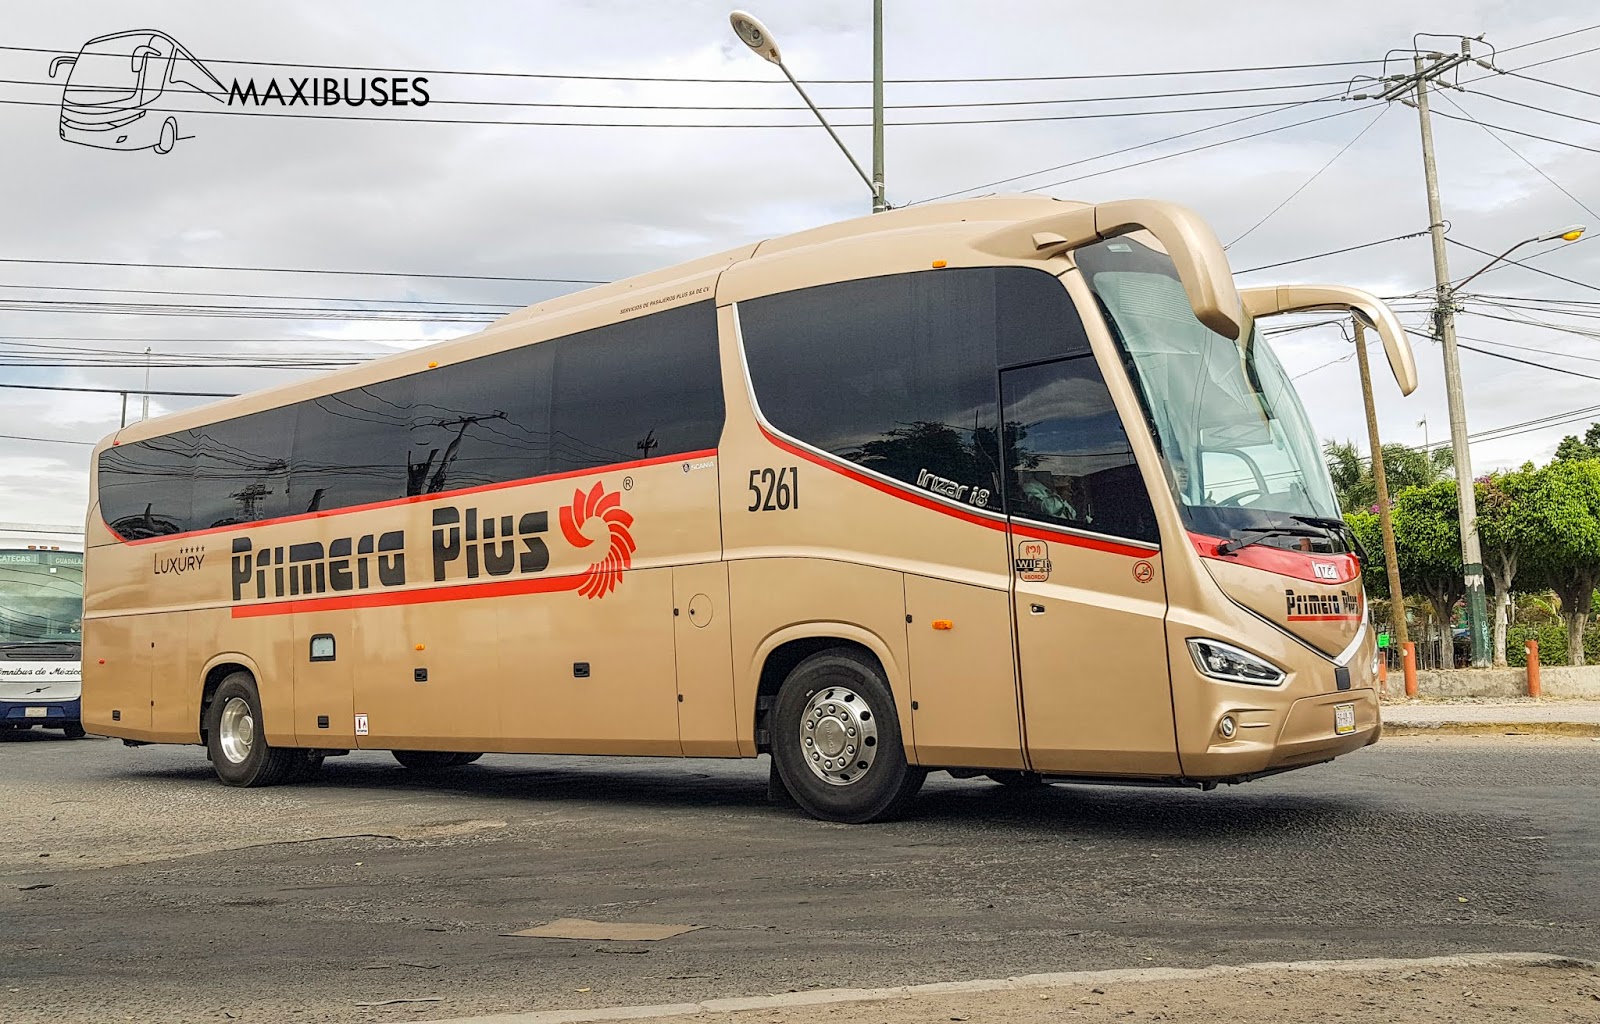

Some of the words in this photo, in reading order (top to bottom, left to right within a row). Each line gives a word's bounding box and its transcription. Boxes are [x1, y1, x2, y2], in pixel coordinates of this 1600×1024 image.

[620, 304, 642, 314] SERVICIOS
[650, 295, 675, 306] PASAJEROS
[690, 461, 714, 471] SCANIA
[748, 466, 799, 512] 5261
[969, 485, 990, 508] i8
[231, 529, 406, 601] Primera
[431, 505, 550, 582] Plus
[1285, 589, 1340, 615] Primera
[34, 667, 47, 675] de
